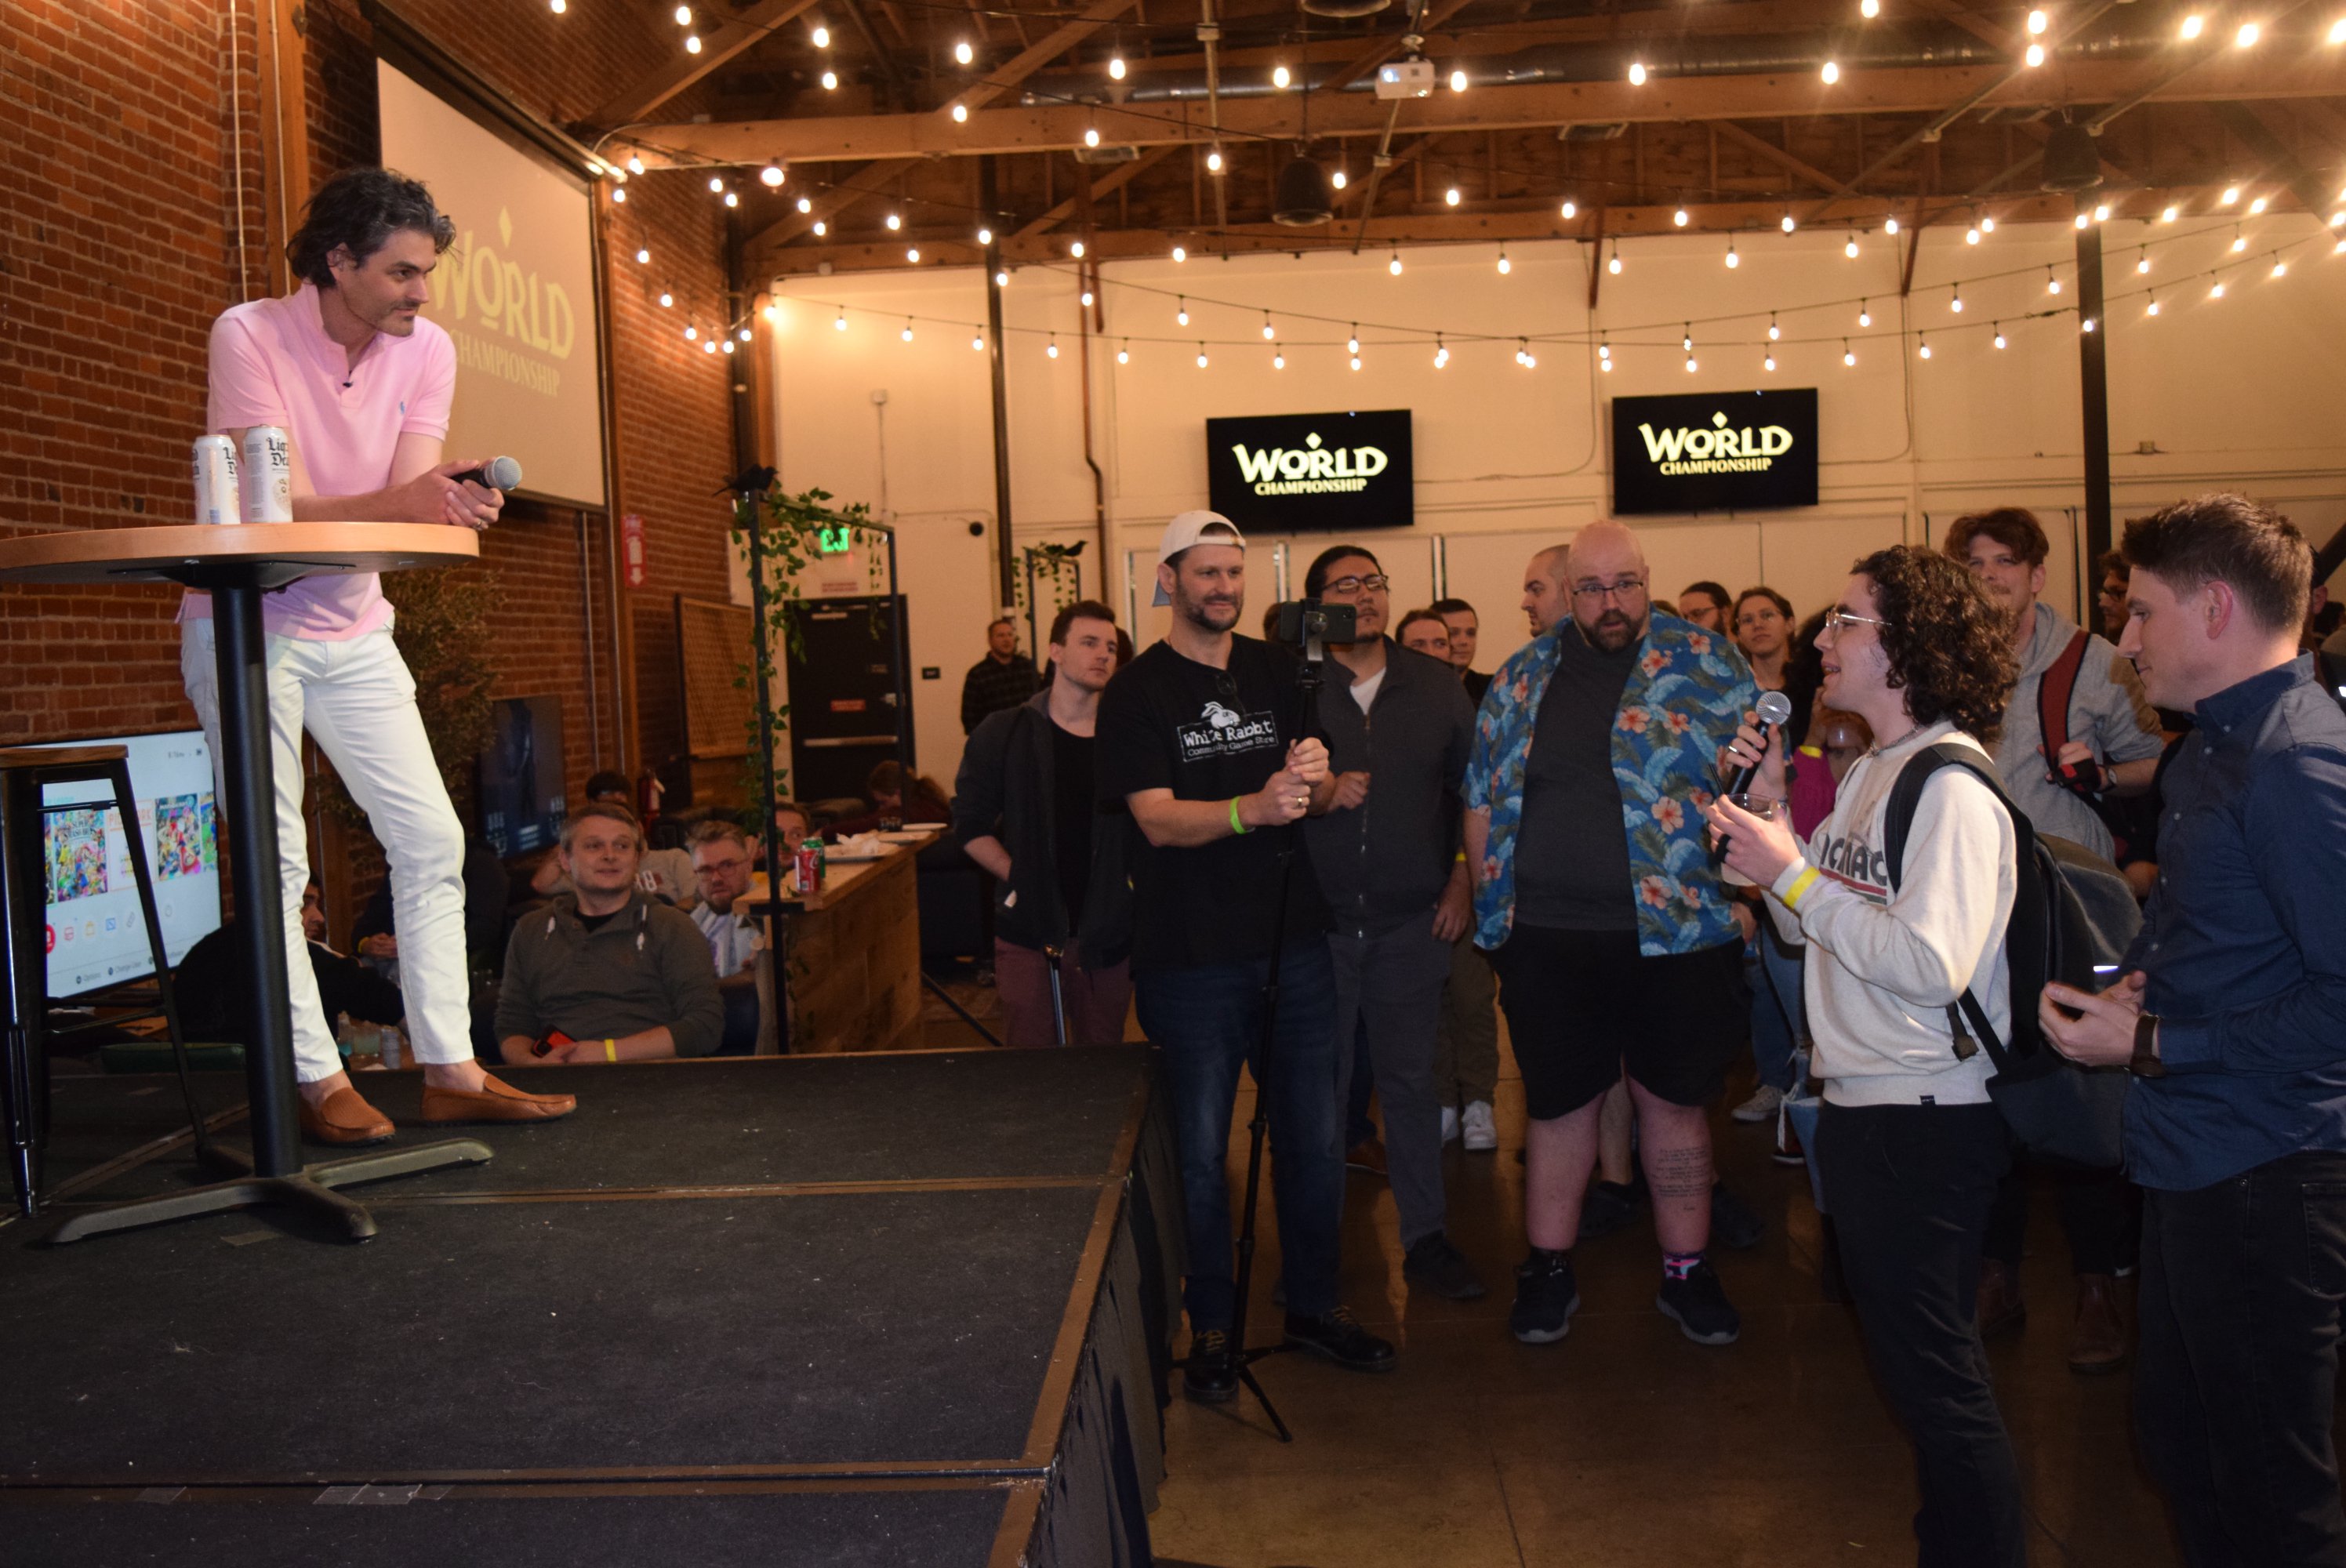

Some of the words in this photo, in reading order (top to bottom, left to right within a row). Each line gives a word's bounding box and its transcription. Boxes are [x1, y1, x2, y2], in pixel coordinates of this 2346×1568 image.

[433, 230, 575, 360] WORLD
[266, 437, 289, 456] Liq
[1638, 423, 1793, 463] WORLD
[1232, 444, 1388, 483] WORLD
[1660, 458, 1772, 475] CHAMPIONSHIP
[1255, 478, 1367, 495] CHAMPIONSHIP
[1229, 739, 1254, 750] Game
